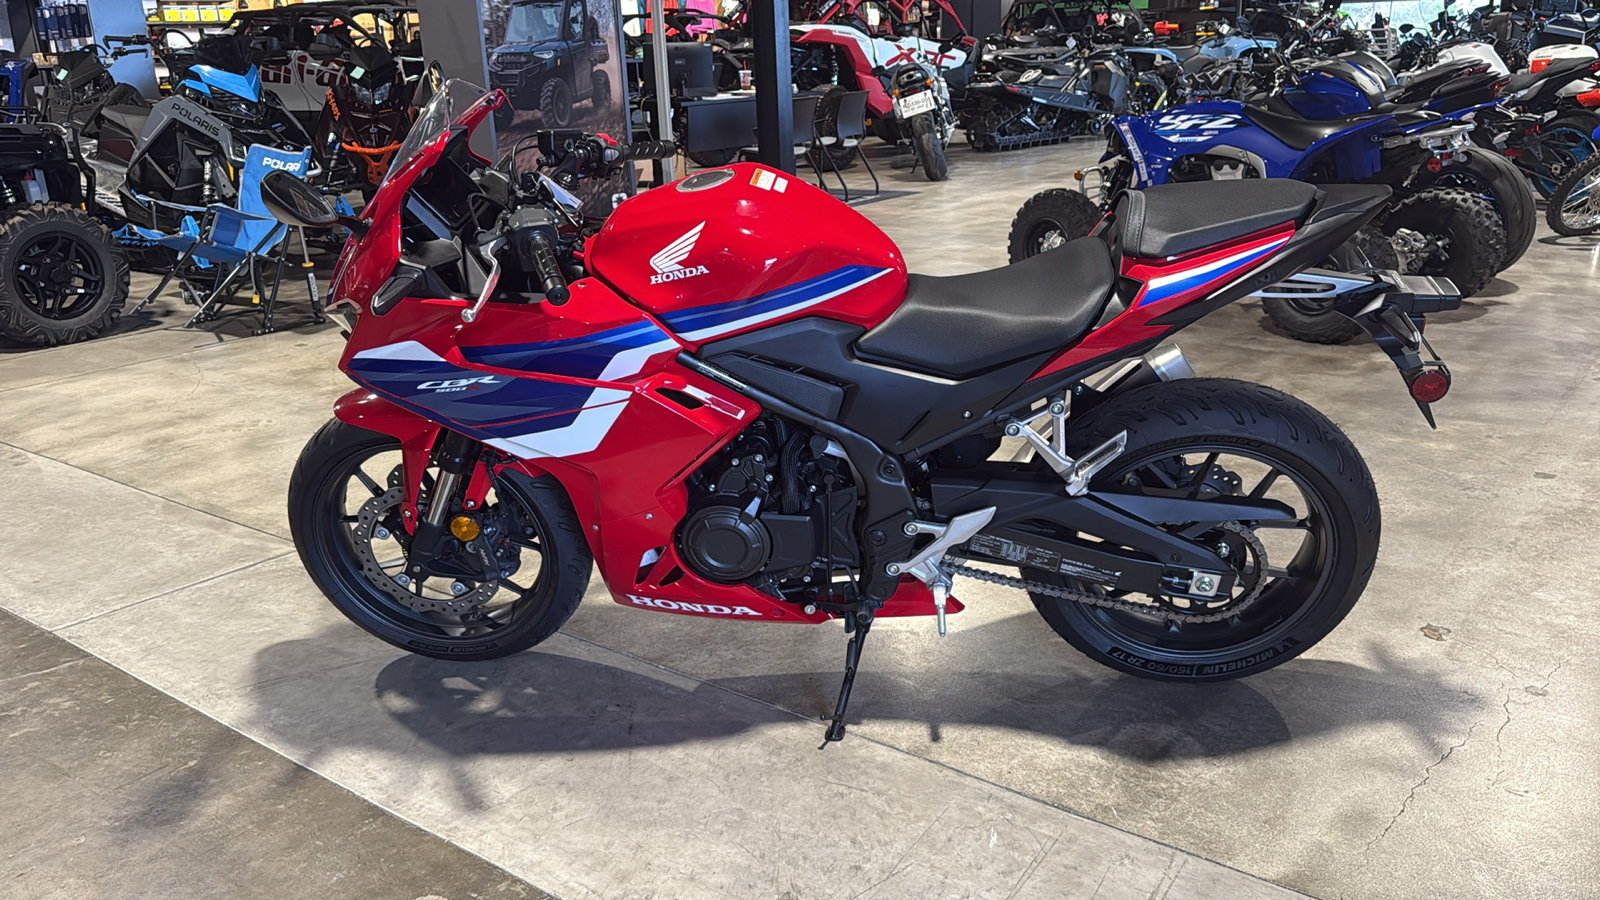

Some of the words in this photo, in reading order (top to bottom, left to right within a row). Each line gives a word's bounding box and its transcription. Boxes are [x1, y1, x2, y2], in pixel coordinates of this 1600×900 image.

[171, 102, 221, 137] POLARIS
[1155, 114, 1242, 130] YFZ
[650, 265, 710, 285] HONDA
[416, 375, 502, 389] CBR
[626, 594, 762, 616] HONDA
[1112, 651, 1126, 660] 17
[1127, 656, 1145, 667] ZR
[1202, 648, 1274, 674] MICHELIN
[1147, 662, 1192, 674] 160/60
